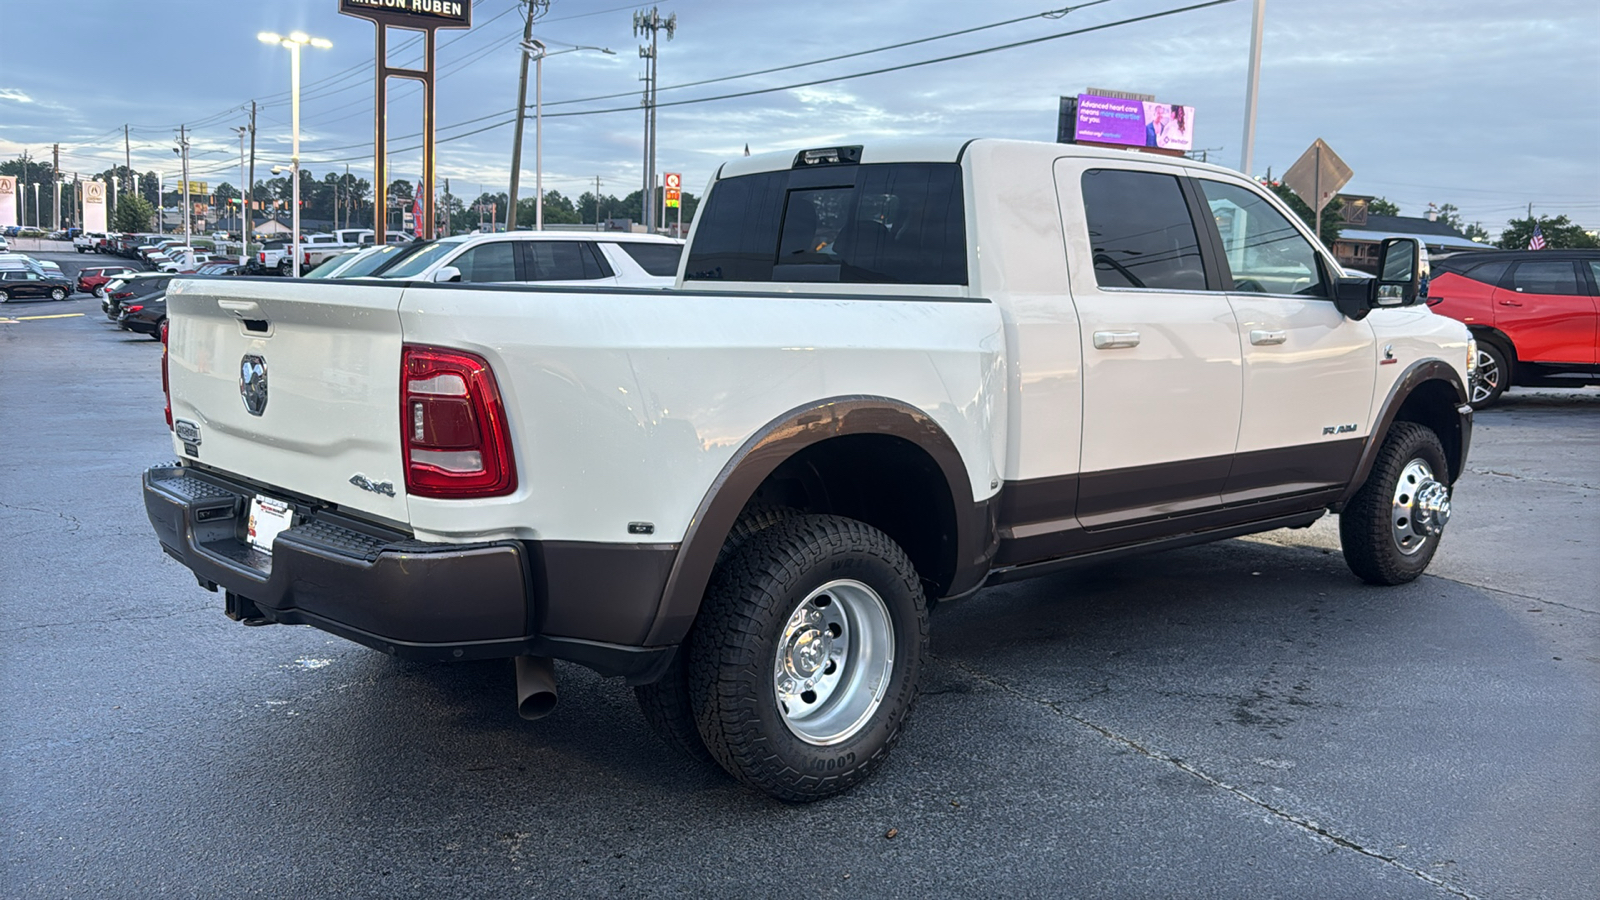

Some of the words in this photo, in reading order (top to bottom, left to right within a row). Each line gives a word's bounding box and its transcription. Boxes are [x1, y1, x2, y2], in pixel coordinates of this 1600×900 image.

[352, 0, 406, 8] LON
[412, 0, 461, 15] RUBEN
[1080, 100, 1108, 110] Advanced
[1322, 424, 1357, 435] RAM
